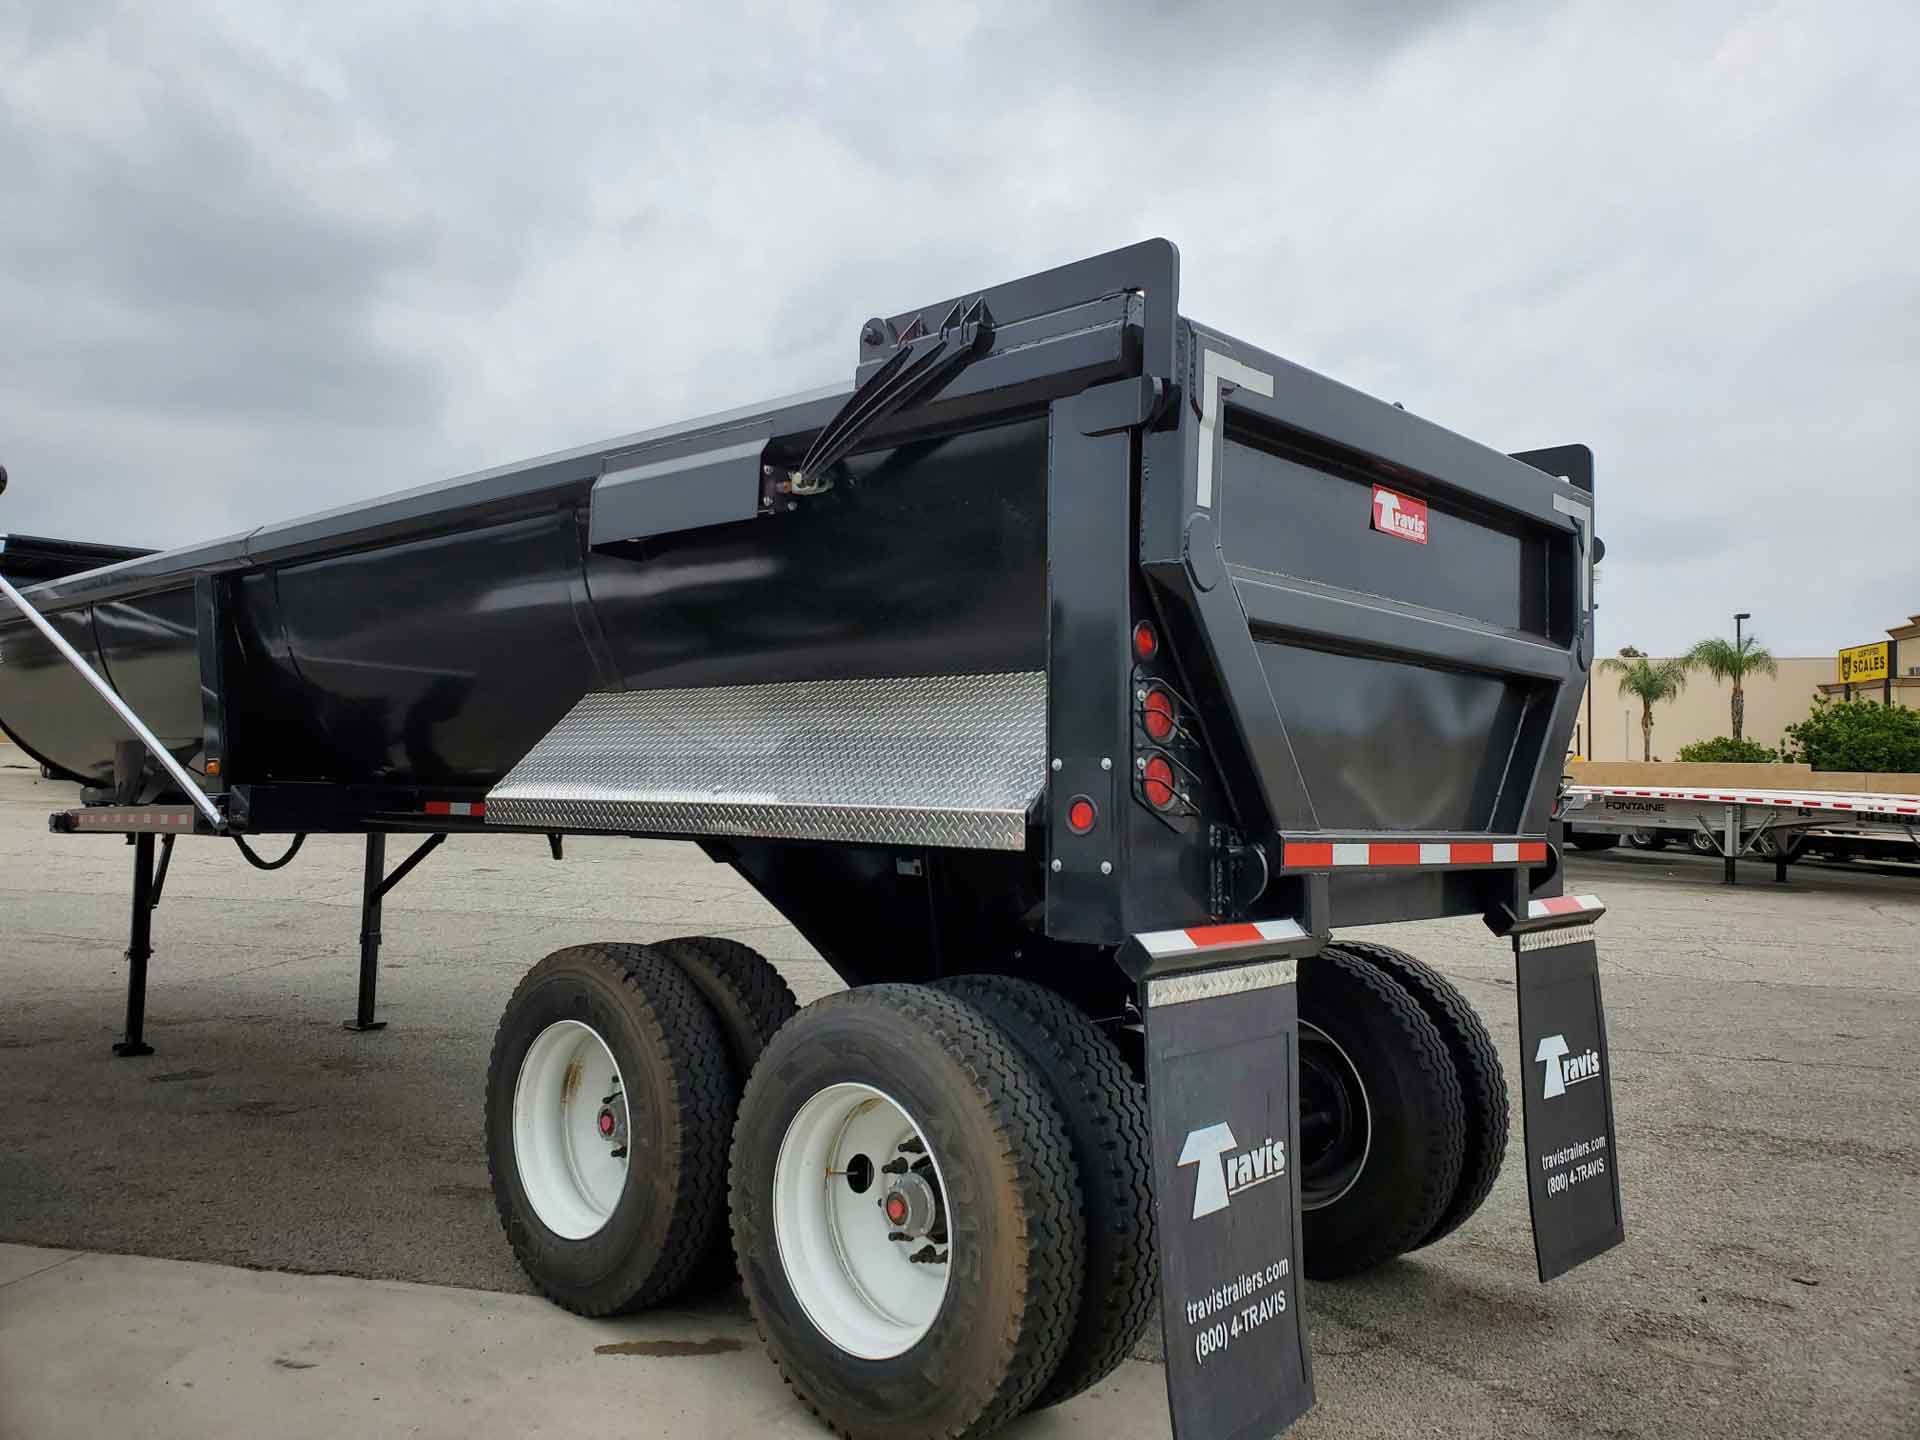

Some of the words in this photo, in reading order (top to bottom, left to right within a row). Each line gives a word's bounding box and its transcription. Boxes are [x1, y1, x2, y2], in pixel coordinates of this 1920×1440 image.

[1374, 489, 1425, 534] Travis
[1853, 656, 1885, 674] SCALES
[1606, 801, 1665, 812] FONTAINE
[1535, 1034, 1600, 1100] Travis
[1177, 1121, 1286, 1220] Travis
[1542, 1135, 1606, 1171] travistrailers.com
[1547, 1172, 1569, 1199] (800)
[1569, 1157, 1605, 1185] 4-TRAVIS
[1186, 1257, 1289, 1325] travistrailers.com
[1195, 1321, 1228, 1365] (800)
[1230, 1289, 1286, 1339] 4-TRAVIS
